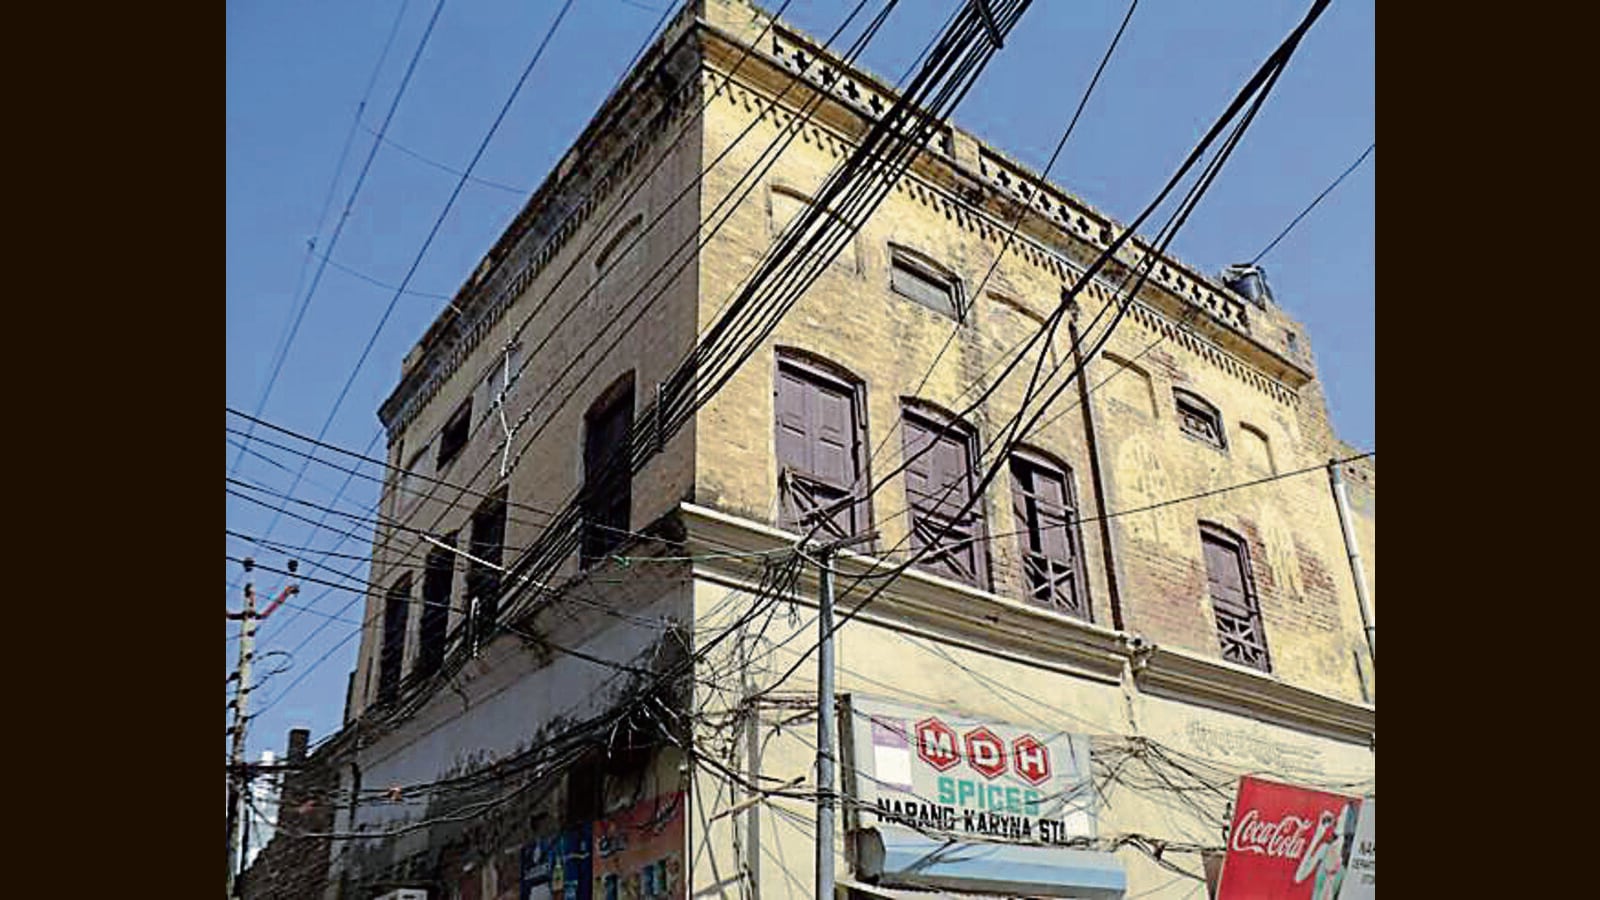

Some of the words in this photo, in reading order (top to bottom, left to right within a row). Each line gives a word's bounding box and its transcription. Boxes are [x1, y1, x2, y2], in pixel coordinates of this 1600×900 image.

[920, 726, 1050, 778] MDH
[937, 776, 1040, 815] SPICES
[877, 798, 955, 831] NARANG
[964, 809, 1032, 839] KARYNA
